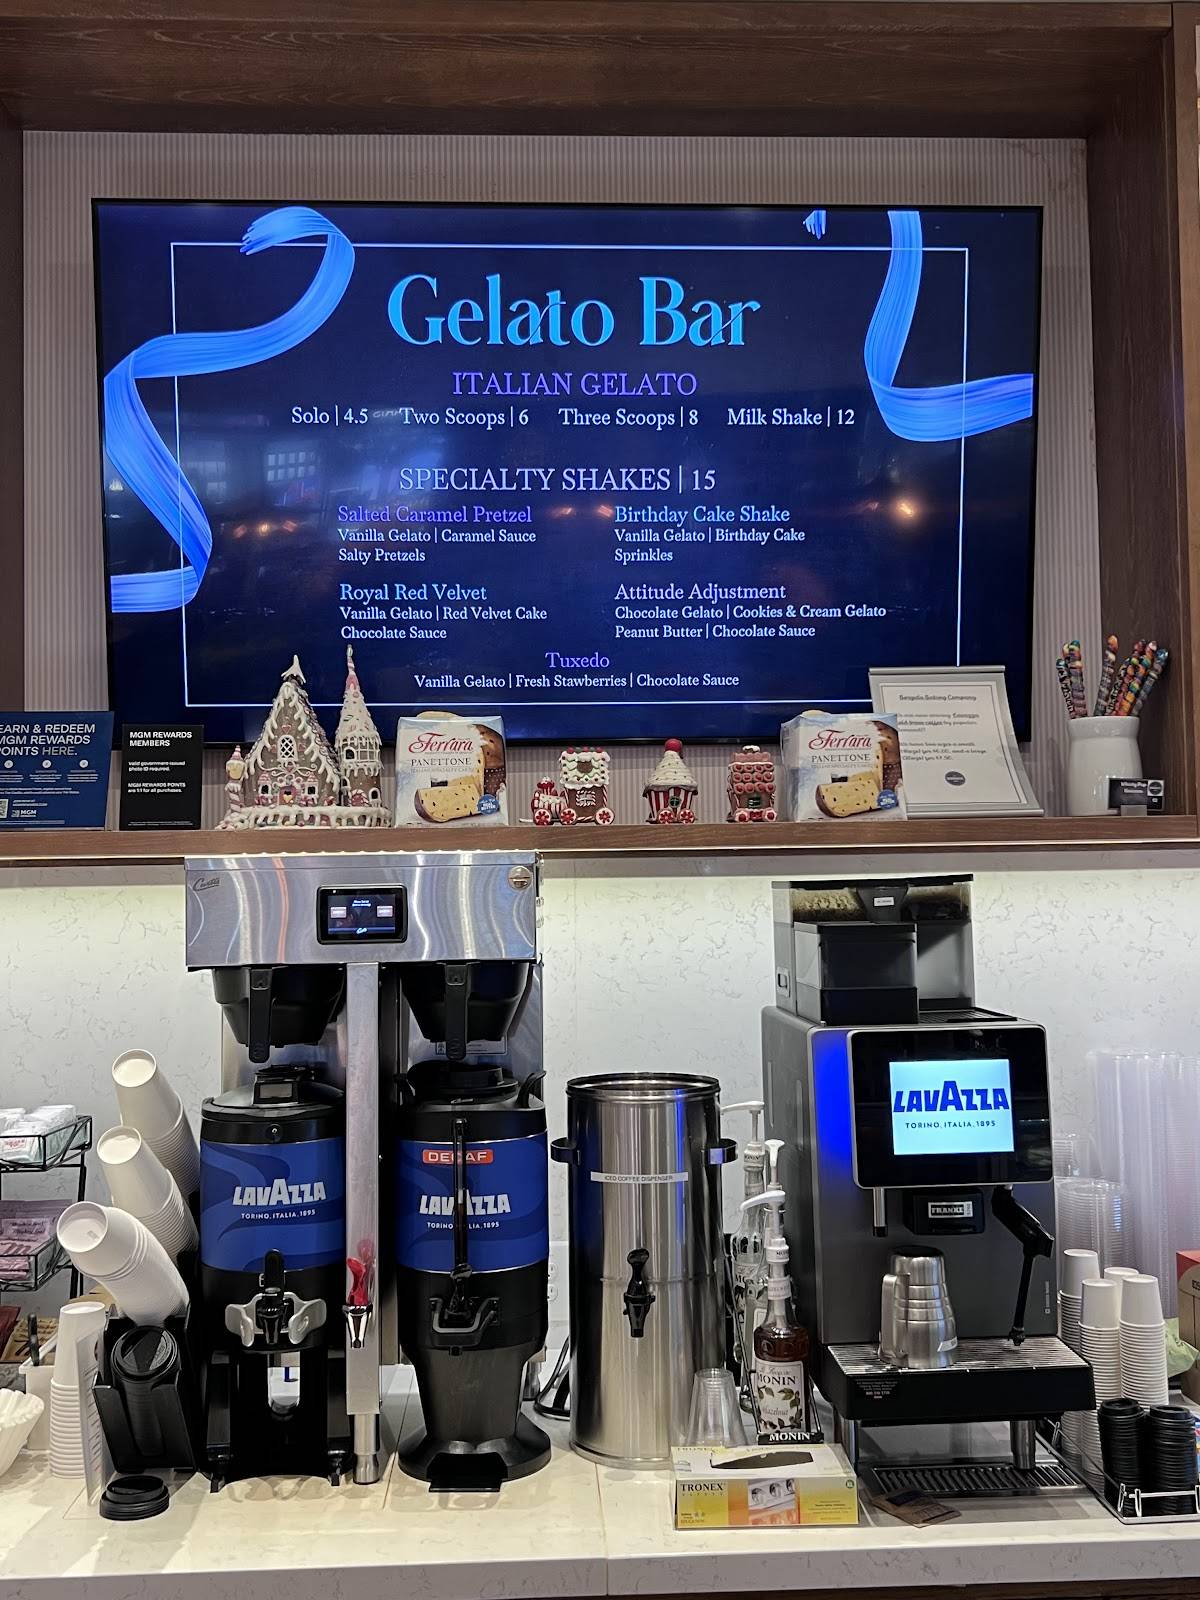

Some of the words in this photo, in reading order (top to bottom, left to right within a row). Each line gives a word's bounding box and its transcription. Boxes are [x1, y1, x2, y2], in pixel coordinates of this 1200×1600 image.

[387, 273, 614, 346] Gelato
[639, 277, 761, 346] Bar
[452, 372, 572, 395] ITALIAN
[580, 372, 697, 396] GELATO
[291, 406, 329, 424] Solo
[344, 408, 368, 424] 4.5
[400, 407, 439, 424] Two
[445, 408, 505, 430] Scoops
[518, 408, 529, 425] 6
[558, 408, 611, 426] Three
[615, 408, 675, 430] Scoops
[688, 409, 699, 425] 8
[727, 408, 767, 425] Milk
[772, 408, 822, 425] Shake
[836, 409, 855, 425] 12
[400, 467, 555, 490] SPECIALTY
[562, 468, 671, 490] SHAKES
[692, 469, 716, 490] 15
[338, 505, 390, 522] Salted
[396, 506, 467, 522] Caramel
[473, 506, 532, 522] Pretzel
[614, 506, 688, 527] Birthday
[693, 506, 735, 522] Cake
[740, 505, 790, 522] Shake
[337, 529, 384, 542] Vanilla
[388, 529, 431, 542] Gelato
[441, 529, 495, 542] Caramel
[499, 530, 536, 542] Sauce
[614, 528, 660, 542] Vanilla
[663, 528, 705, 542] Gelato
[715, 528, 770, 545] Birthday
[773, 528, 805, 541] Cake
[338, 548, 371, 565] Salty
[374, 548, 425, 561] Pretzels
[614, 548, 673, 565] Sprinkles
[340, 584, 389, 605] Royal
[395, 584, 428, 600] Red
[432, 584, 487, 600] Velvet
[614, 583, 684, 600] Attitude
[688, 583, 786, 604] Adjustment
[340, 606, 387, 620] Vanilla
[390, 606, 433, 620] Gelato
[443, 606, 468, 620] Red
[471, 606, 512, 619] Velvet
[515, 606, 547, 619] Cake
[615, 606, 678, 619] Chocolate
[682, 605, 723, 619] Gelato
[733, 605, 783, 618] Cookies
[786, 605, 797, 618] &
[800, 605, 841, 618] Cream
[845, 604, 886, 617] Gelato
[341, 626, 406, 639] Chocolate
[409, 626, 447, 639] Sauce
[615, 625, 659, 638] Peanut
[663, 625, 703, 638] Butter
[712, 624, 776, 637] Chocolate
[778, 624, 815, 637] Sauce
[545, 652, 609, 668] Tuxedo
[414, 675, 460, 688] Vanilla
[463, 675, 506, 688] Gelato
[516, 675, 550, 688] Fresh
[553, 674, 627, 688] Stawberries
[637, 674, 700, 687] Chocolate
[703, 674, 739, 686] Sauce
[0, 724, 29, 734] EARN
[33, 724, 41, 734] &
[45, 724, 95, 734] REDEEM
[129, 731, 151, 739] MGM
[153, 731, 192, 739] REWARDS
[31, 735, 90, 745] REWARDS
[408, 732, 474, 754] Ferrara
[808, 729, 872, 750] Ferrara
[0, 746, 39, 756] OINTS
[42, 746, 78, 756] HERE.
[811, 753, 871, 763] PANETTONE
[411, 757, 472, 767] PANETTONE
[893, 1080, 1010, 1113] LAVAZZA
[233, 1178, 327, 1206] LAVAZZA
[300, 1209, 316, 1217] 1895
[483, 1221, 500, 1229] 1895
[769, 1431, 811, 1442] MONIN
[680, 1483, 724, 1492] TRONEX
